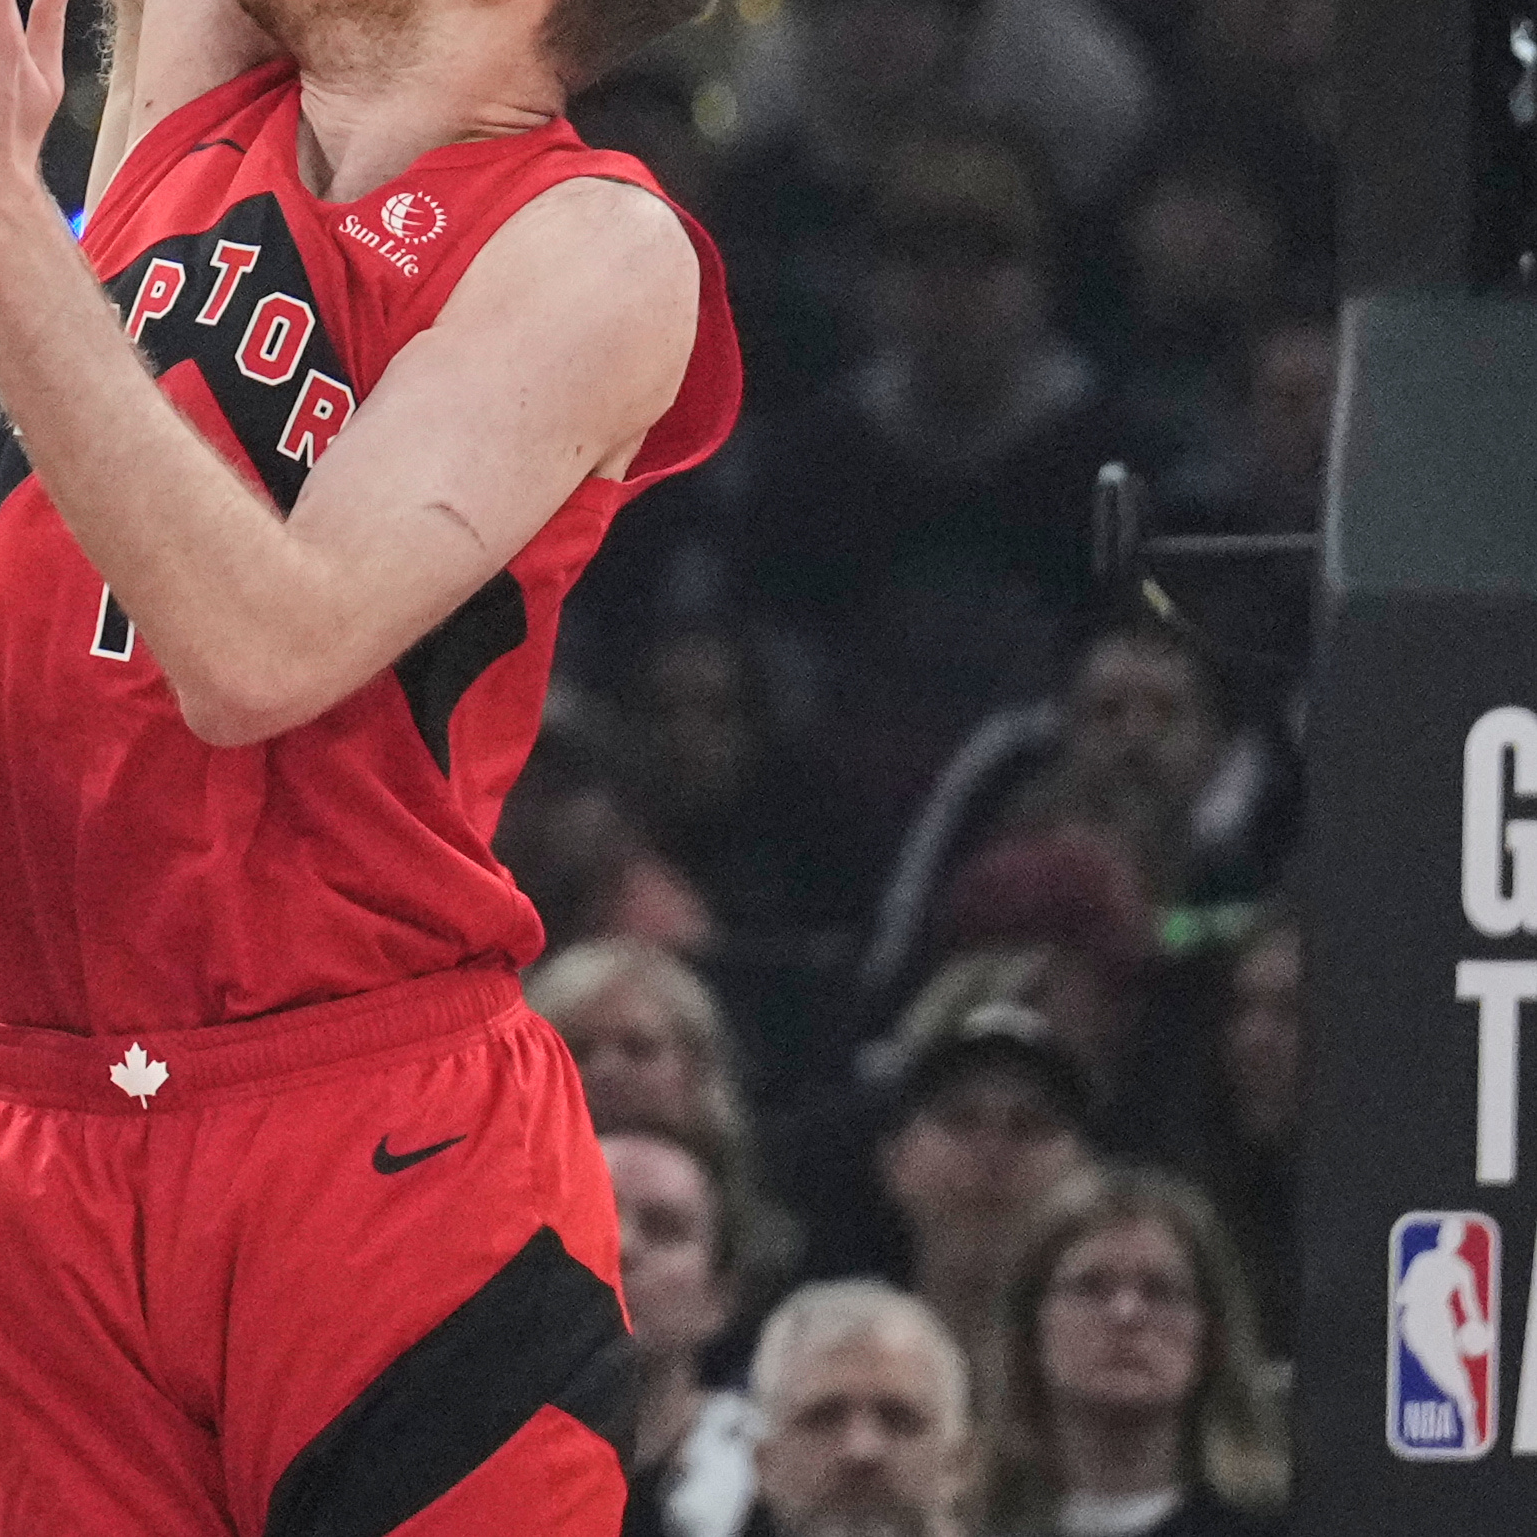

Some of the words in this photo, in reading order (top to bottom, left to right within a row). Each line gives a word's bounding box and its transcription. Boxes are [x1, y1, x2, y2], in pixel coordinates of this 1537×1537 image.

[338, 214, 381, 248] Sun
[378, 239, 420, 278] Life
[110, 240, 356, 468] PTOR
